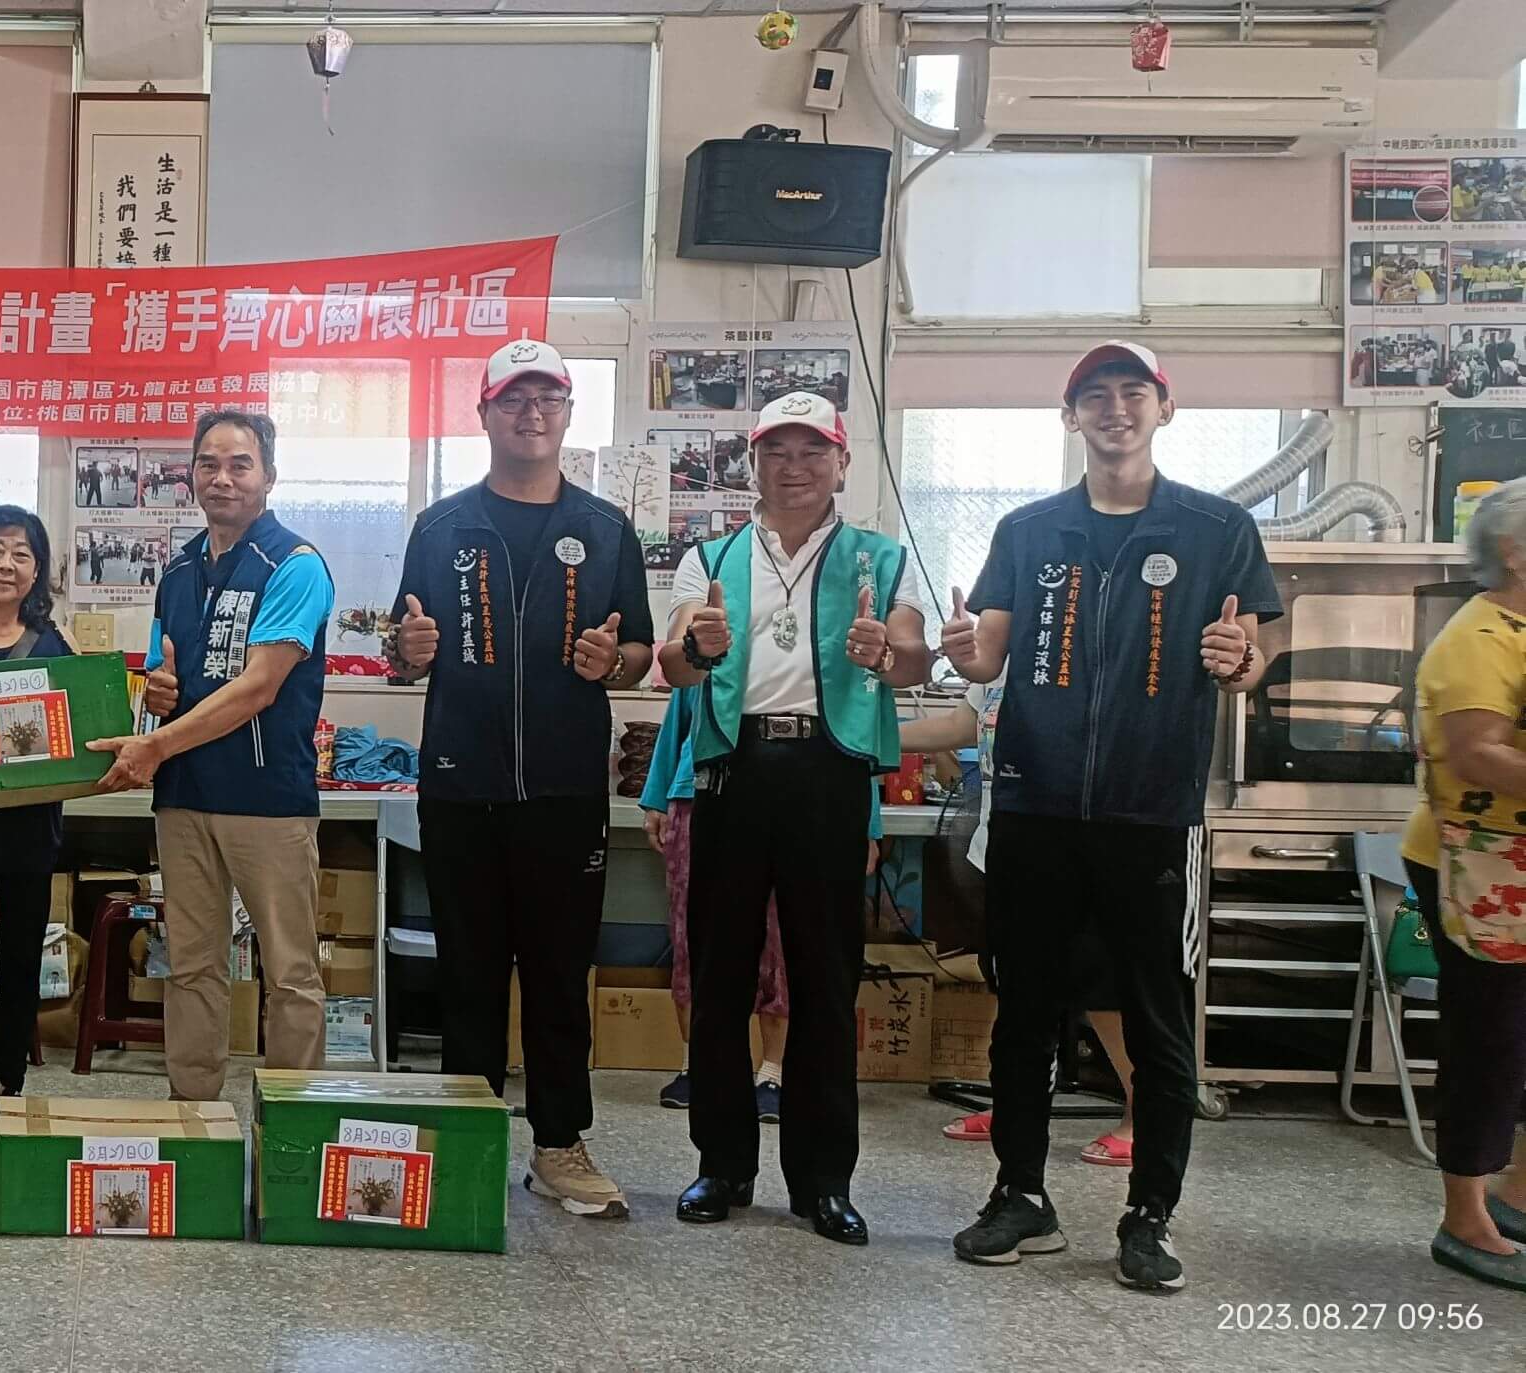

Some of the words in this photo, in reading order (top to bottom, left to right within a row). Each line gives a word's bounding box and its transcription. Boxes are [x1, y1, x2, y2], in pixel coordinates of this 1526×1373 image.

[153, 152, 178, 264] 生活是一種
[203, 589, 240, 679] 陳新榮
